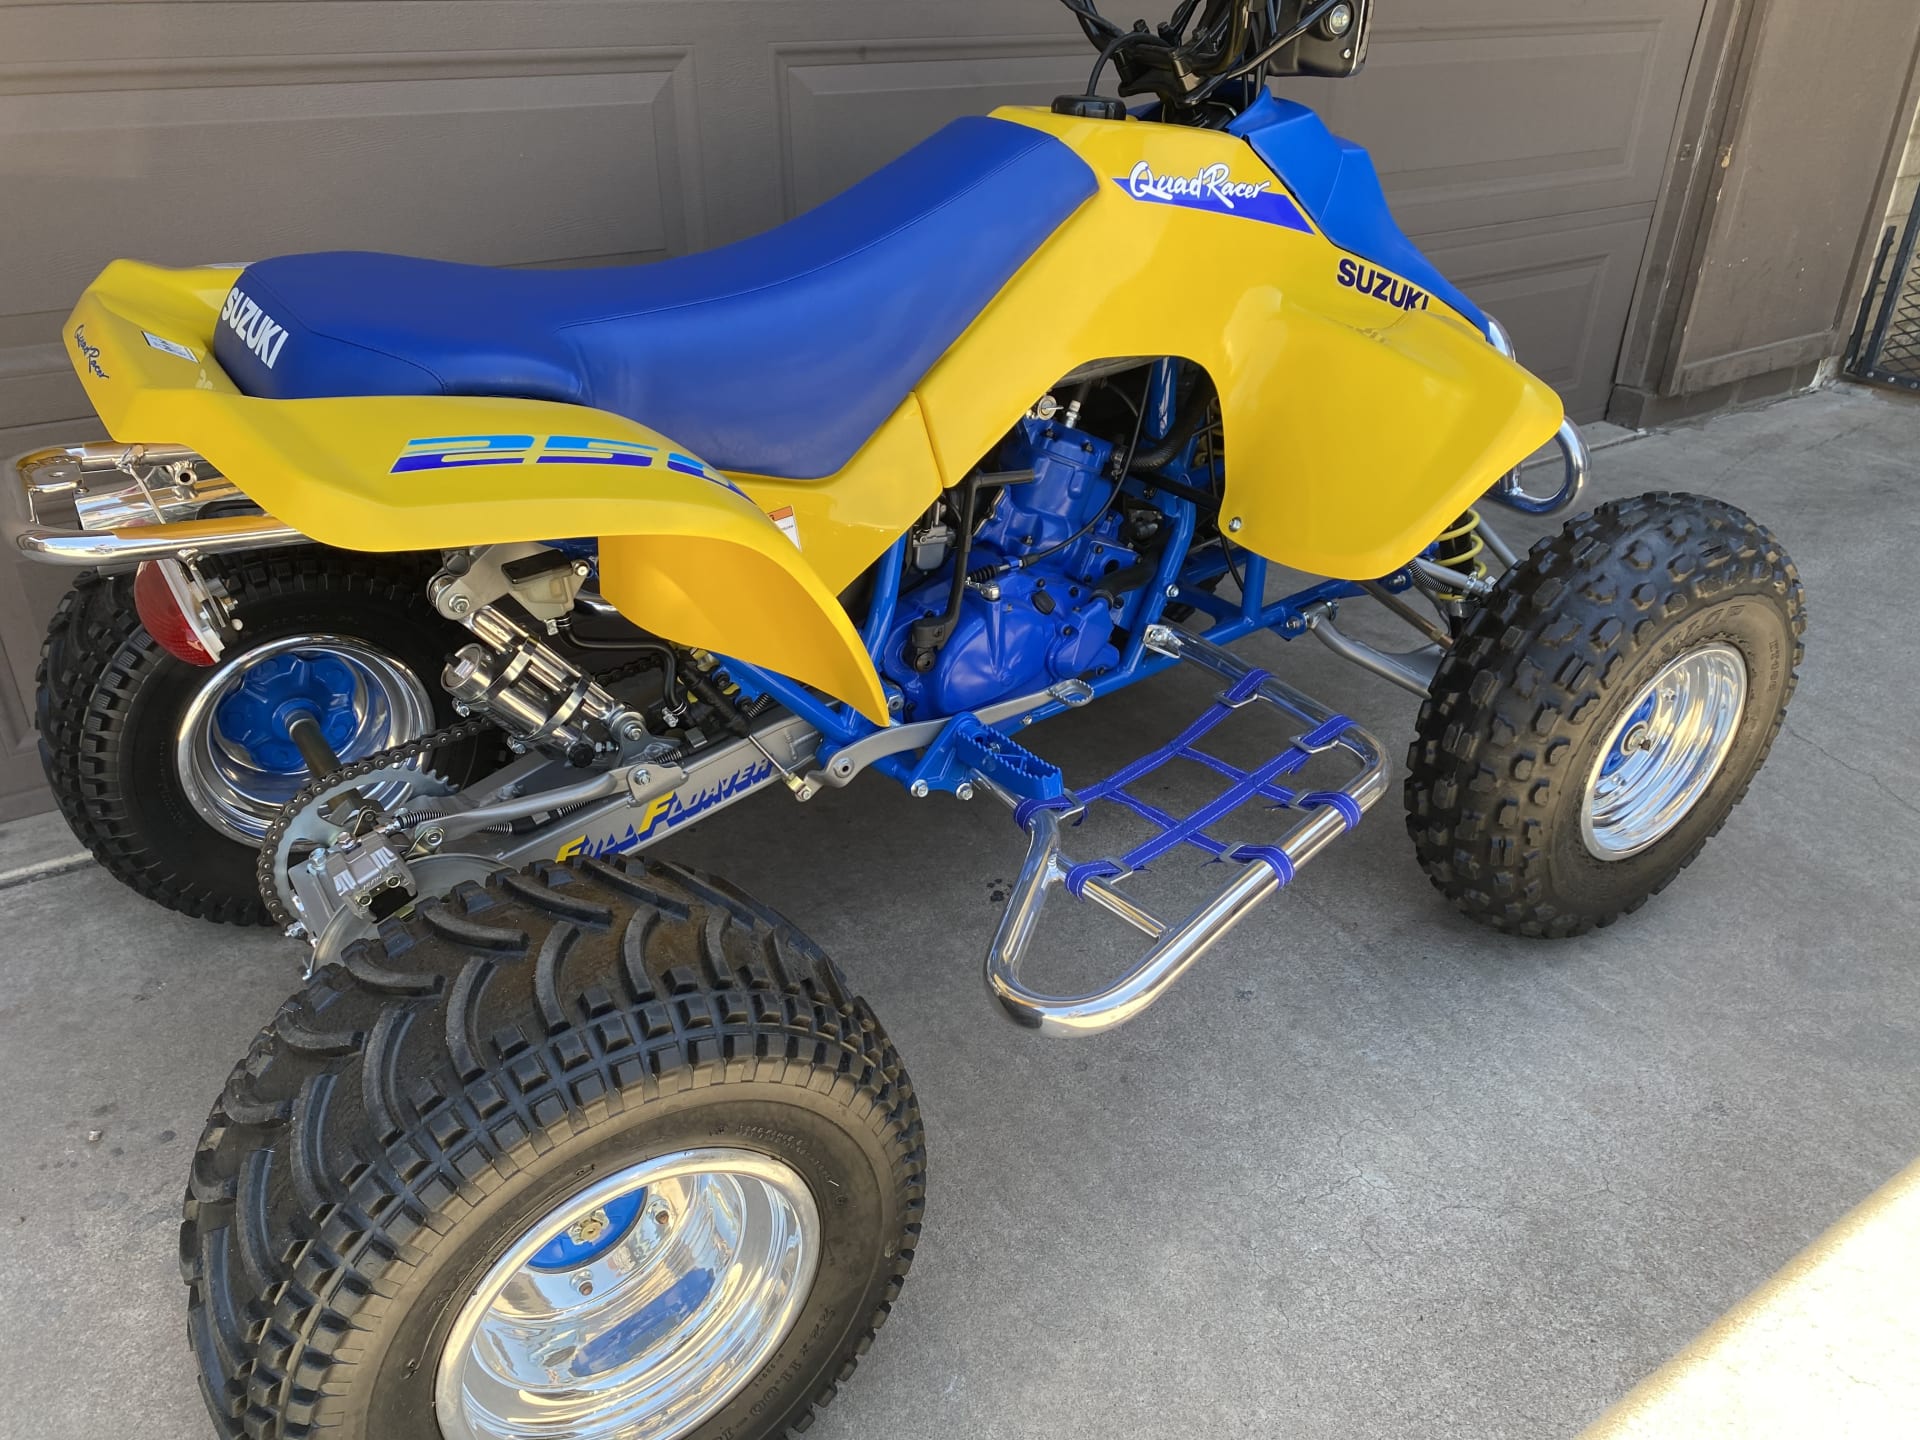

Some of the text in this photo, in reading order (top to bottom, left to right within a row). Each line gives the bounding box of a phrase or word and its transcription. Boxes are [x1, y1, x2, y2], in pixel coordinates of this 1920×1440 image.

[1337, 258, 1430, 311] SUZUKI
[221, 287, 289, 370] SUZUKI
[636, 757, 774, 844] FLOATER
